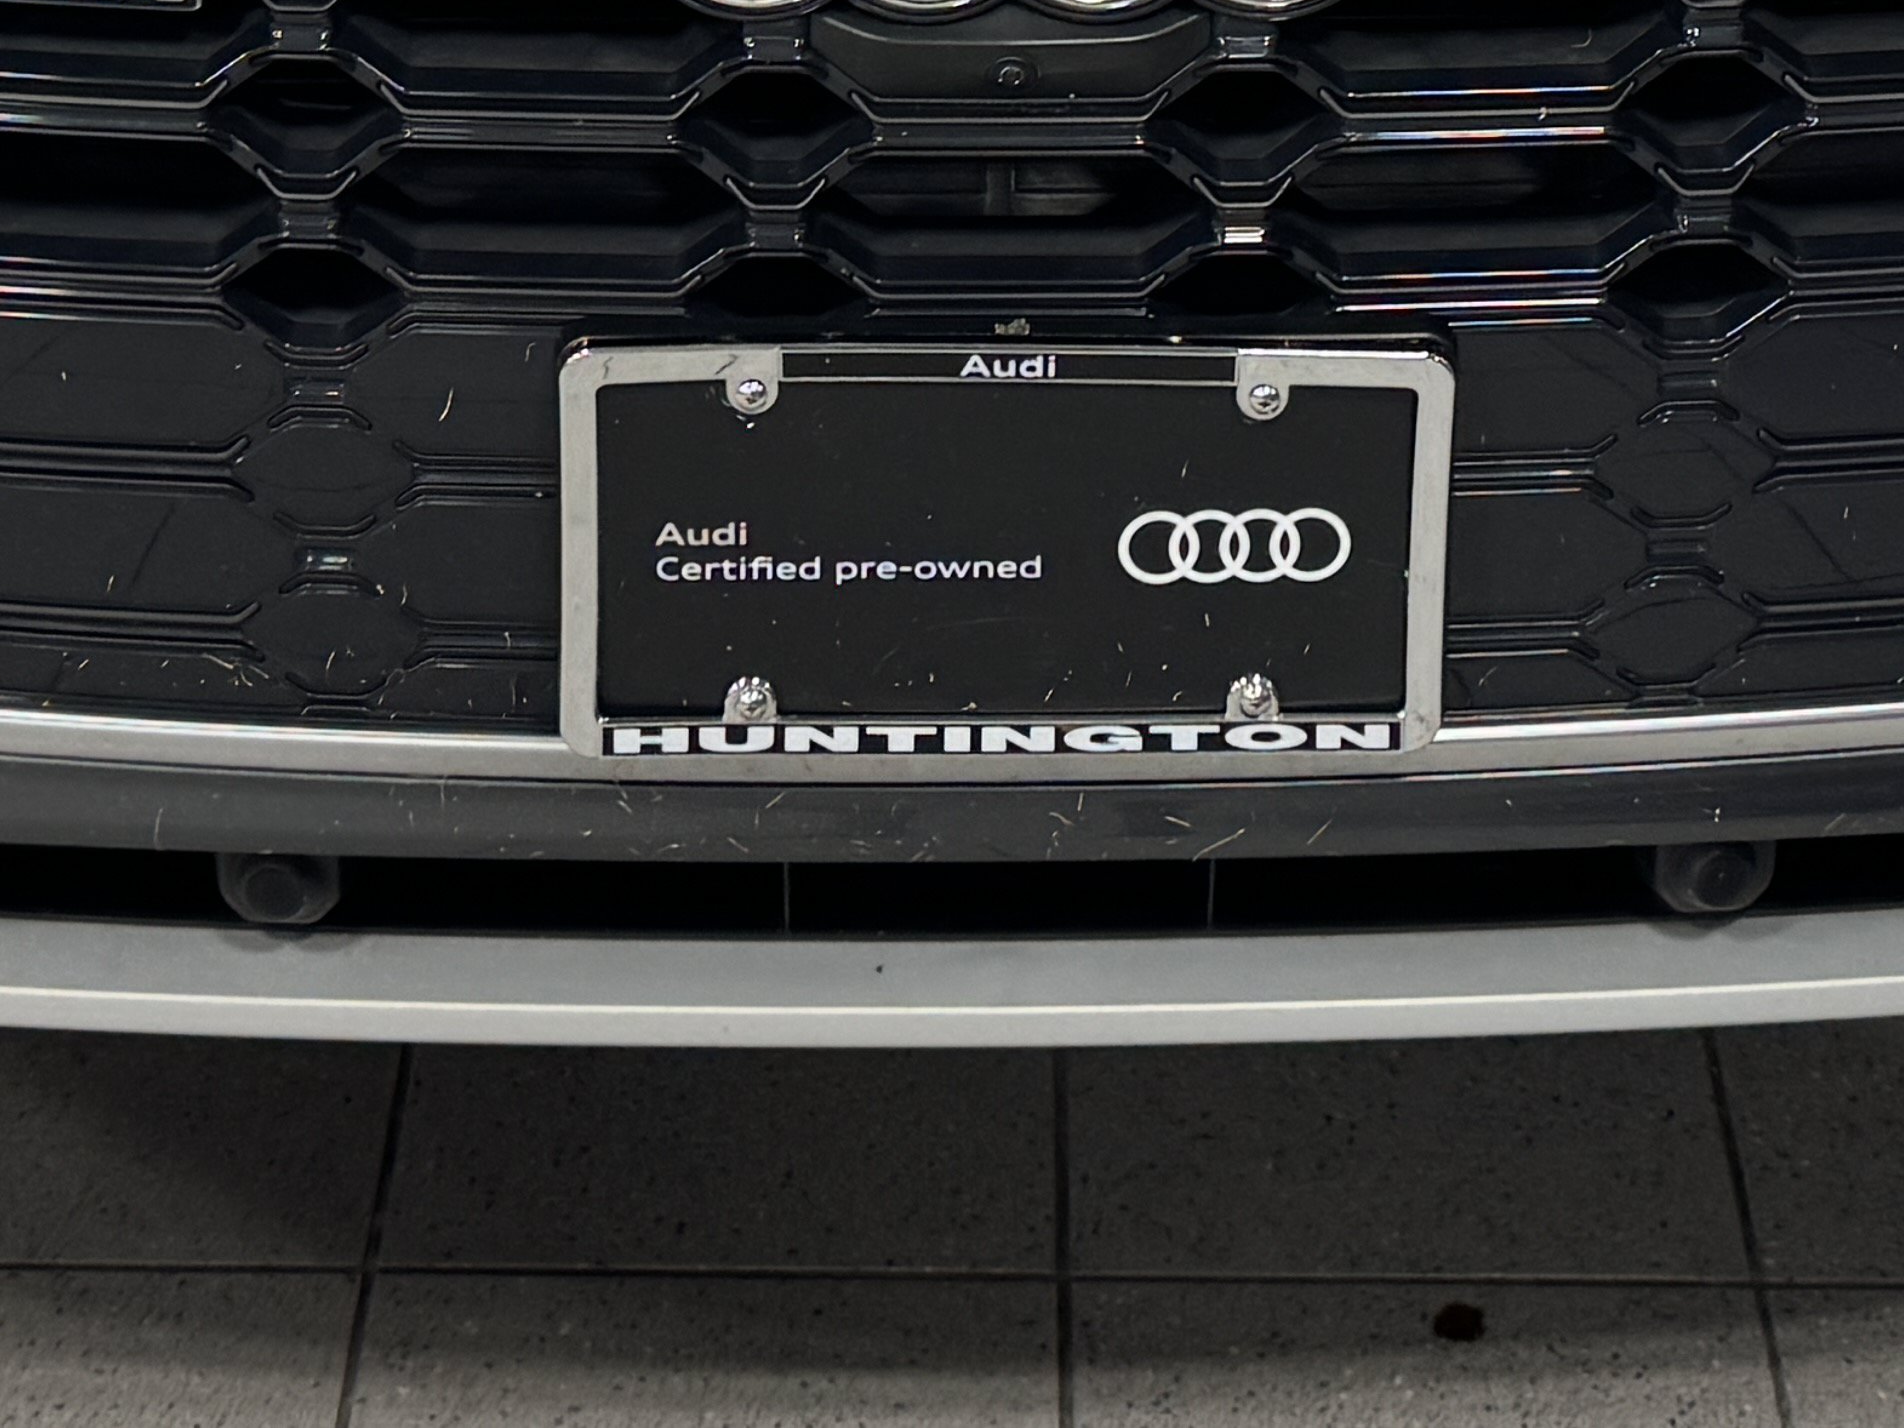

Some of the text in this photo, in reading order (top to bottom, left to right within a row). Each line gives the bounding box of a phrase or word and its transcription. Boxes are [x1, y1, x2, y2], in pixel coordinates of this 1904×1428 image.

[959, 353, 1056, 379] Audi
[655, 521, 748, 546] Audi
[655, 554, 1043, 586] Certified pre-owned
[611, 723, 1392, 753] HUNTINGTON
